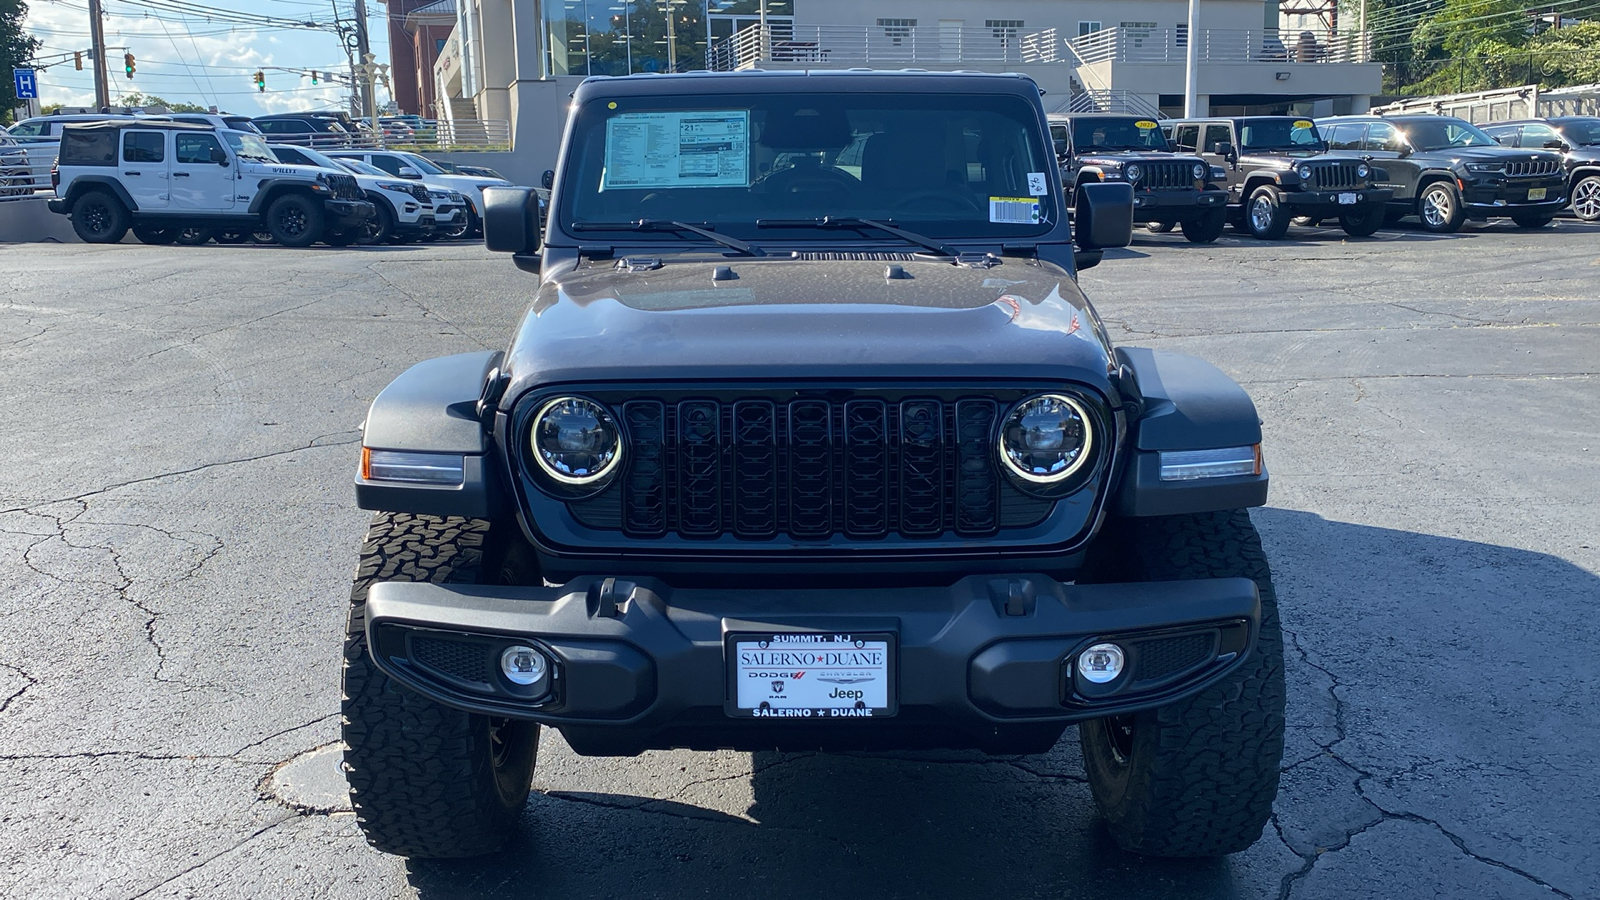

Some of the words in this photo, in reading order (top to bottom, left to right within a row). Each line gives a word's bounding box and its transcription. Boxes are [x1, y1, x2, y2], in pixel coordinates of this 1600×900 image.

[20, 76, 31, 90] H
[741, 652, 816, 665] SALERNO
[825, 653, 883, 665] DUANE
[829, 687, 864, 701] Jeep
[752, 708, 811, 717] SALERNO
[831, 708, 873, 717] DUANE
